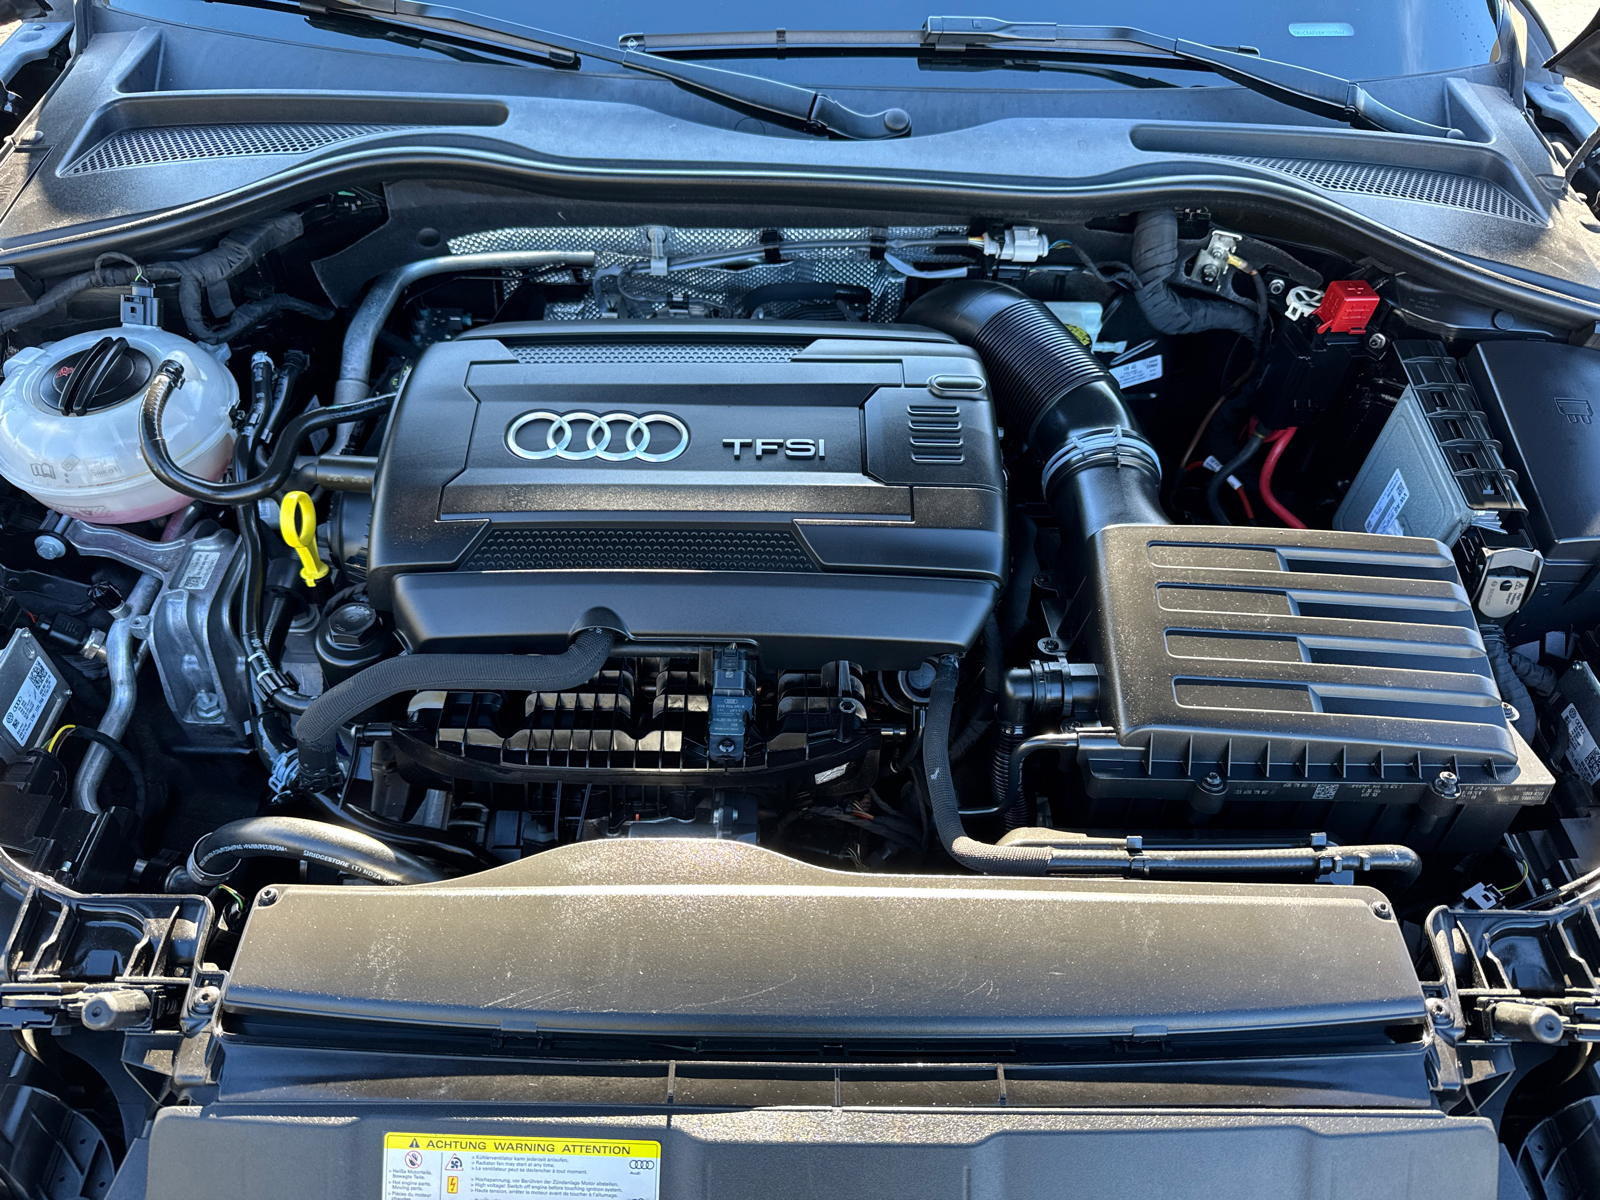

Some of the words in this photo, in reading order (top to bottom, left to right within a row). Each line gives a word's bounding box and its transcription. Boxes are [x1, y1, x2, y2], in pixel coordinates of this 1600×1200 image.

[722, 439, 825, 460] TFSI
[303, 850, 350, 868] BRIDGESTONE
[352, 864, 362, 872] (T)
[426, 1140, 486, 1150] ACHTUNG
[494, 1142, 555, 1153] WARNING
[562, 1144, 630, 1155] ATTENTION
